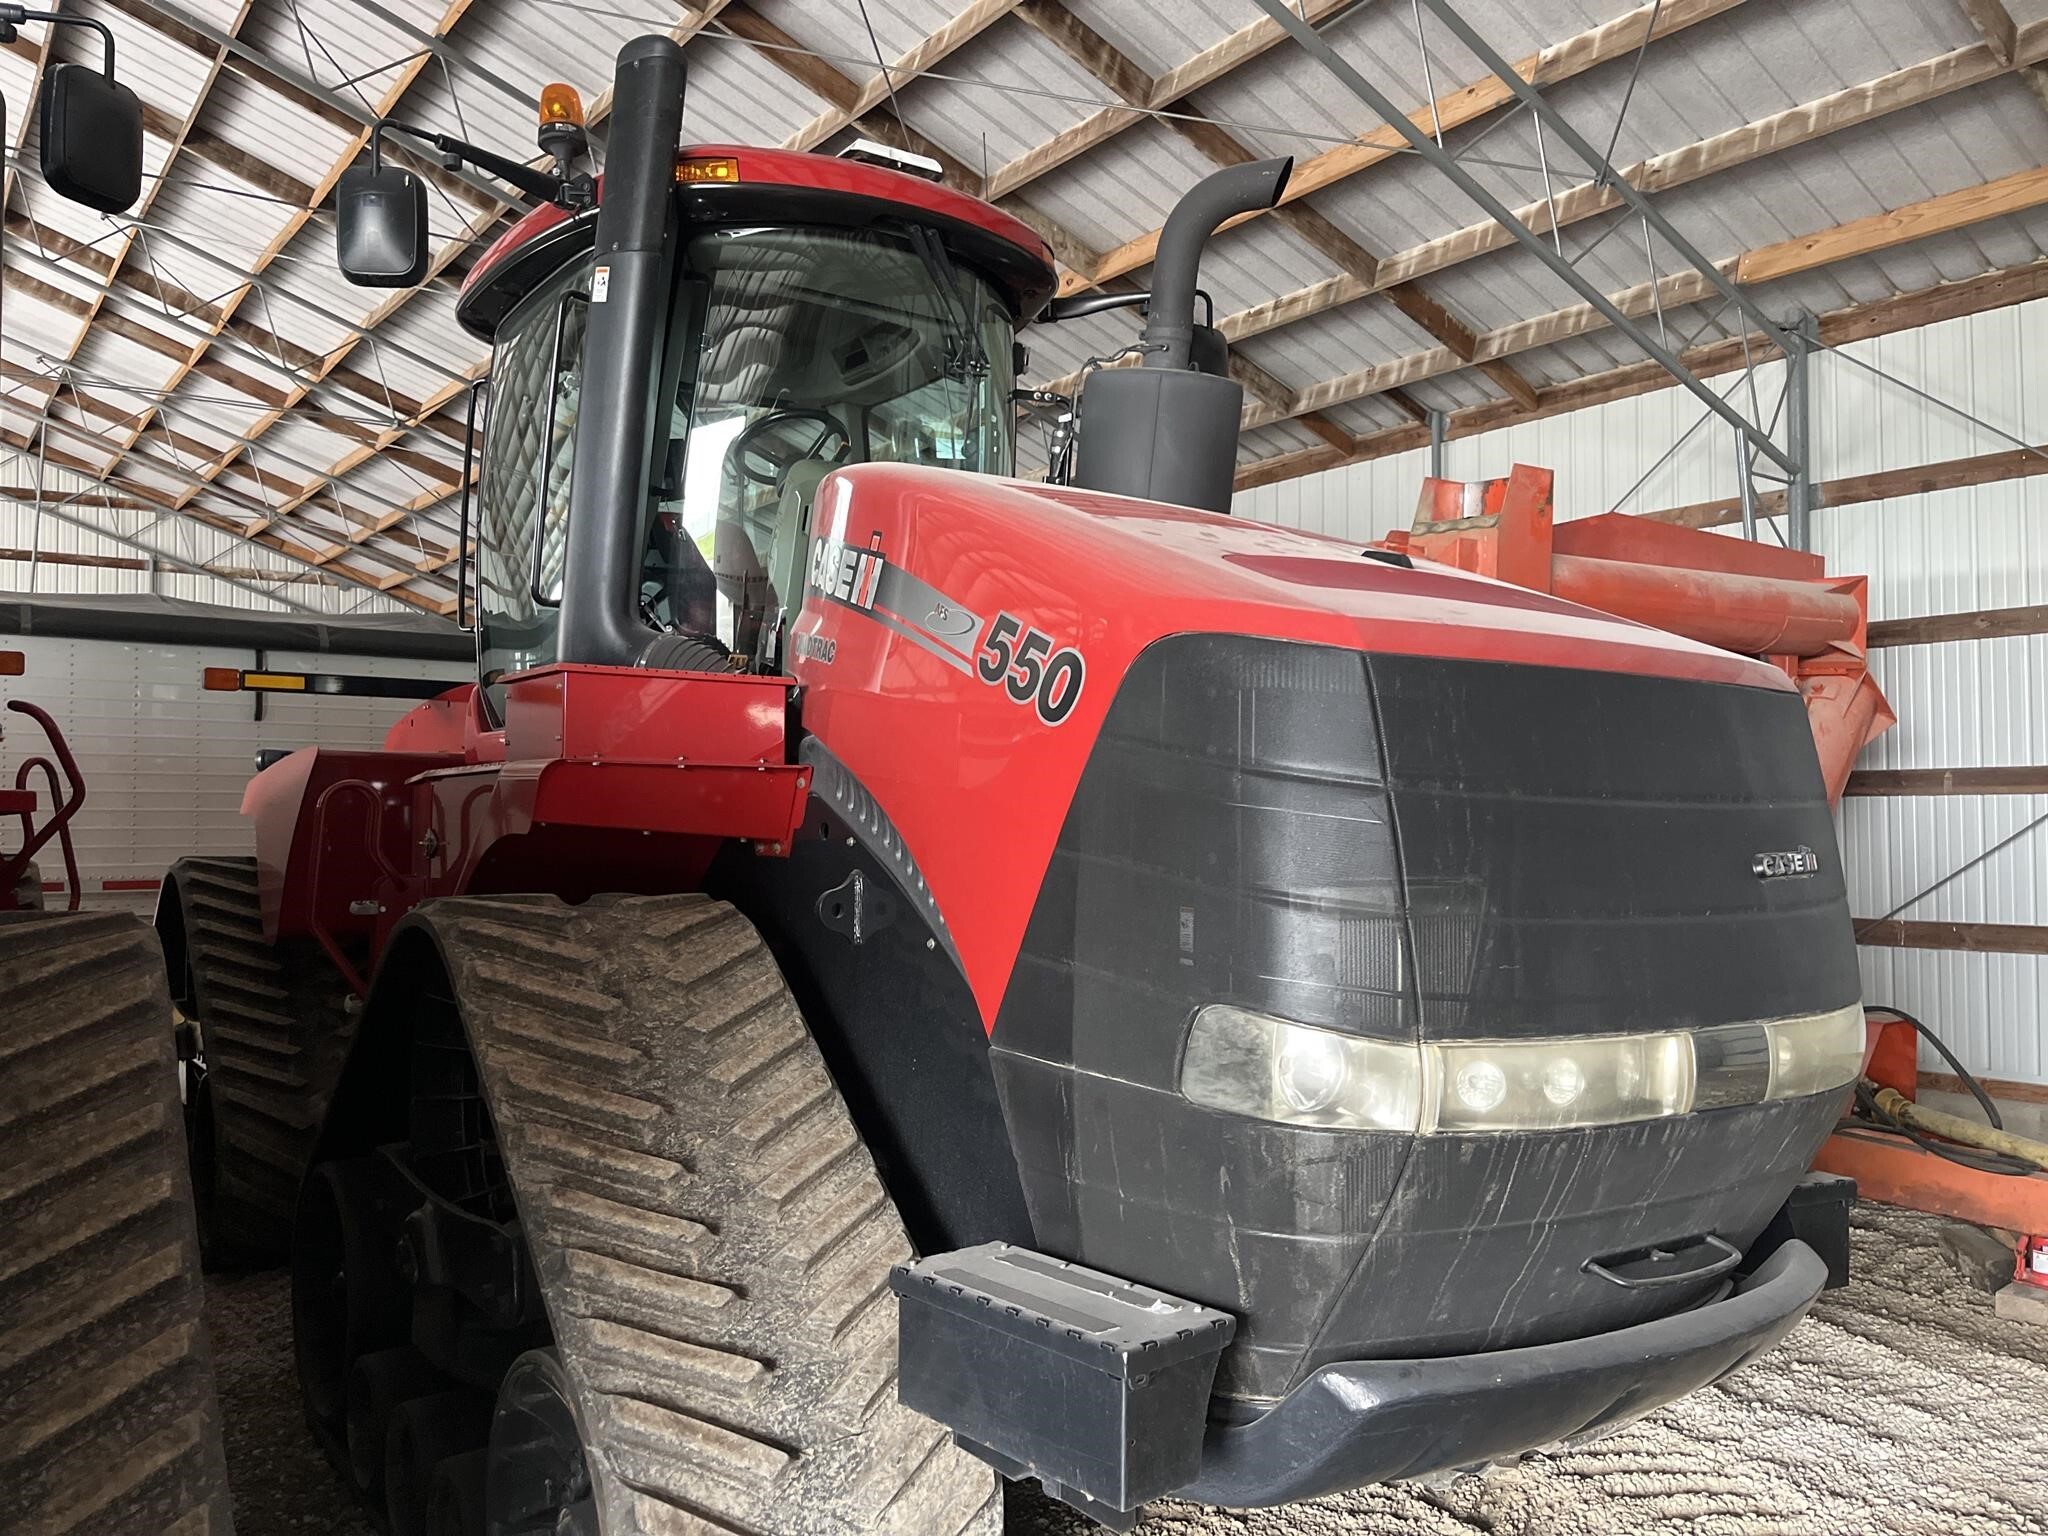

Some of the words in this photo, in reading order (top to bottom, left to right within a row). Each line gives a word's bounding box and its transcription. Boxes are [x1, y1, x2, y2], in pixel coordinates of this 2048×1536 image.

[811, 538, 858, 601] CASE
[978, 611, 1086, 725] 550
[1762, 852, 1804, 876] CASE
